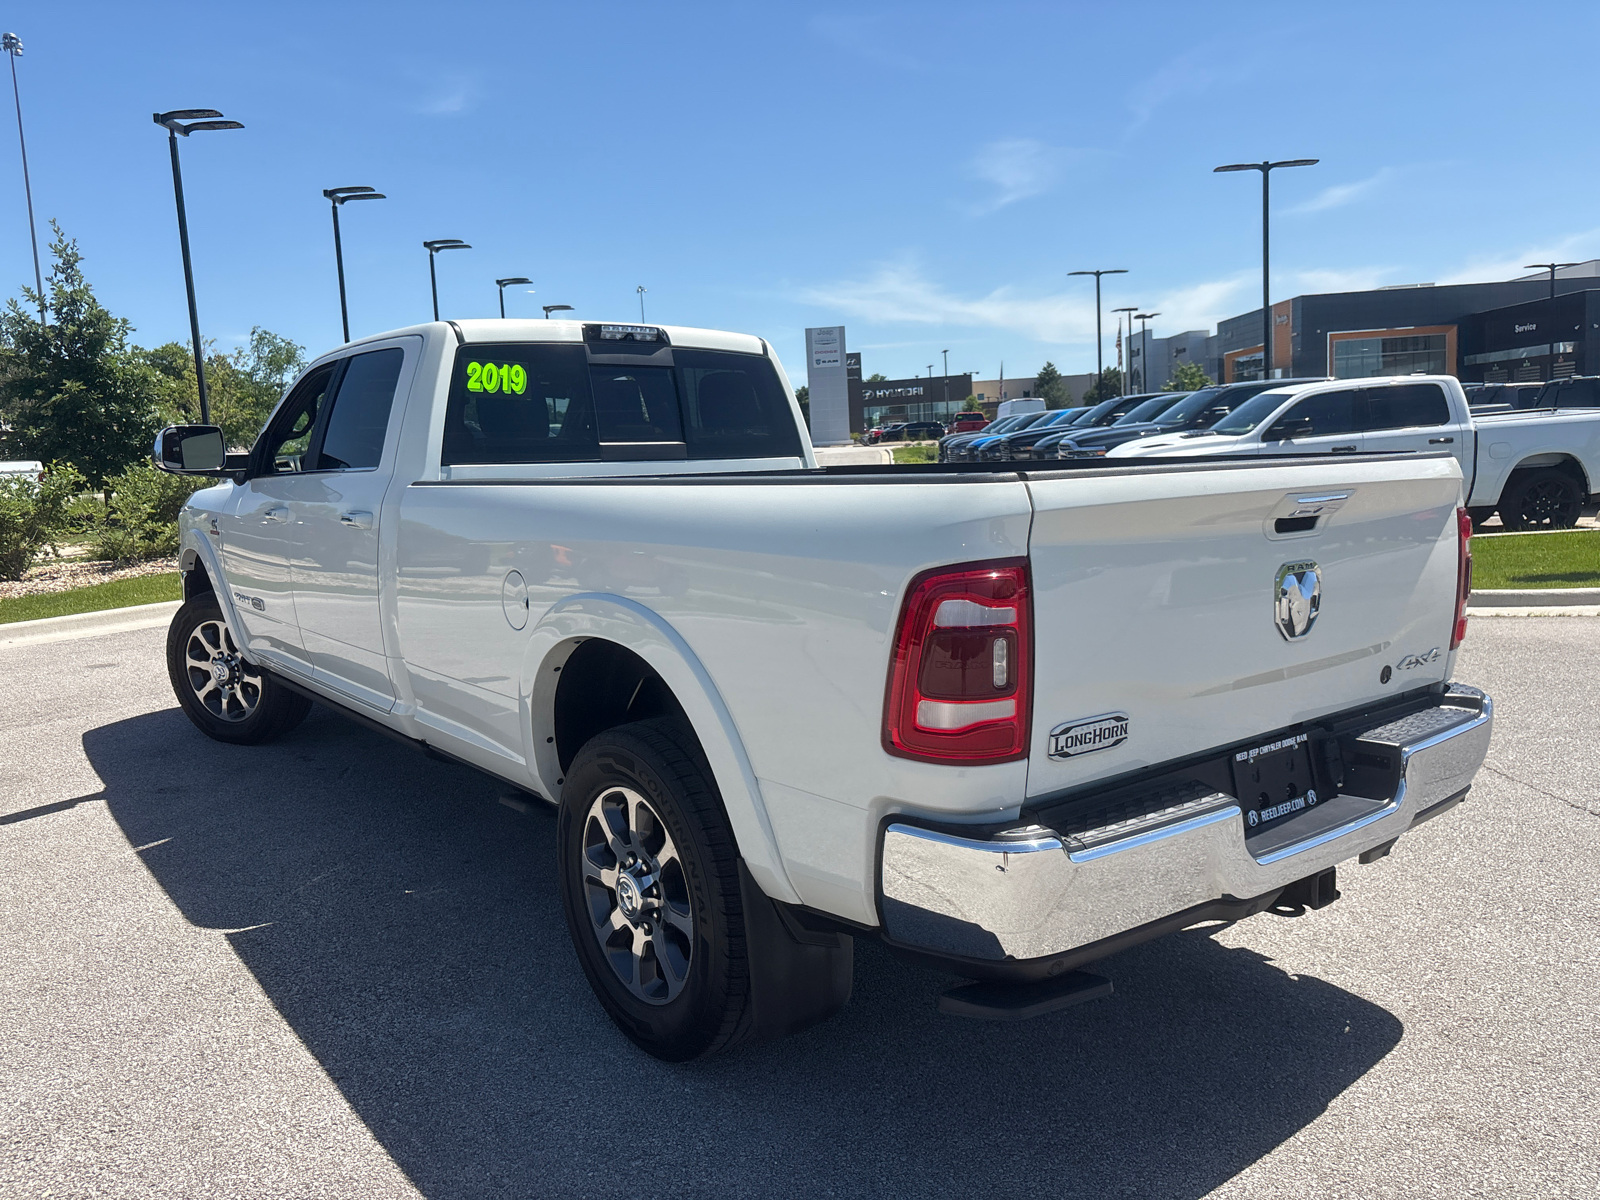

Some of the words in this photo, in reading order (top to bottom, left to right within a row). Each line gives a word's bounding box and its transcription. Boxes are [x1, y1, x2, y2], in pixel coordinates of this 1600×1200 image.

[1514, 323, 1537, 333] Service
[466, 361, 527, 395] 2019
[1287, 562, 1315, 572] RAM
[1236, 752, 1247, 761] REED
[1248, 749, 1259, 758] JEEP
[1260, 742, 1281, 754] CHRYSLER
[1282, 737, 1296, 747] DODGE
[1297, 733, 1307, 742] RAM
[1261, 798, 1305, 821] REEDJEEP.COM
[638, 769, 707, 925] CONTINENTAL
